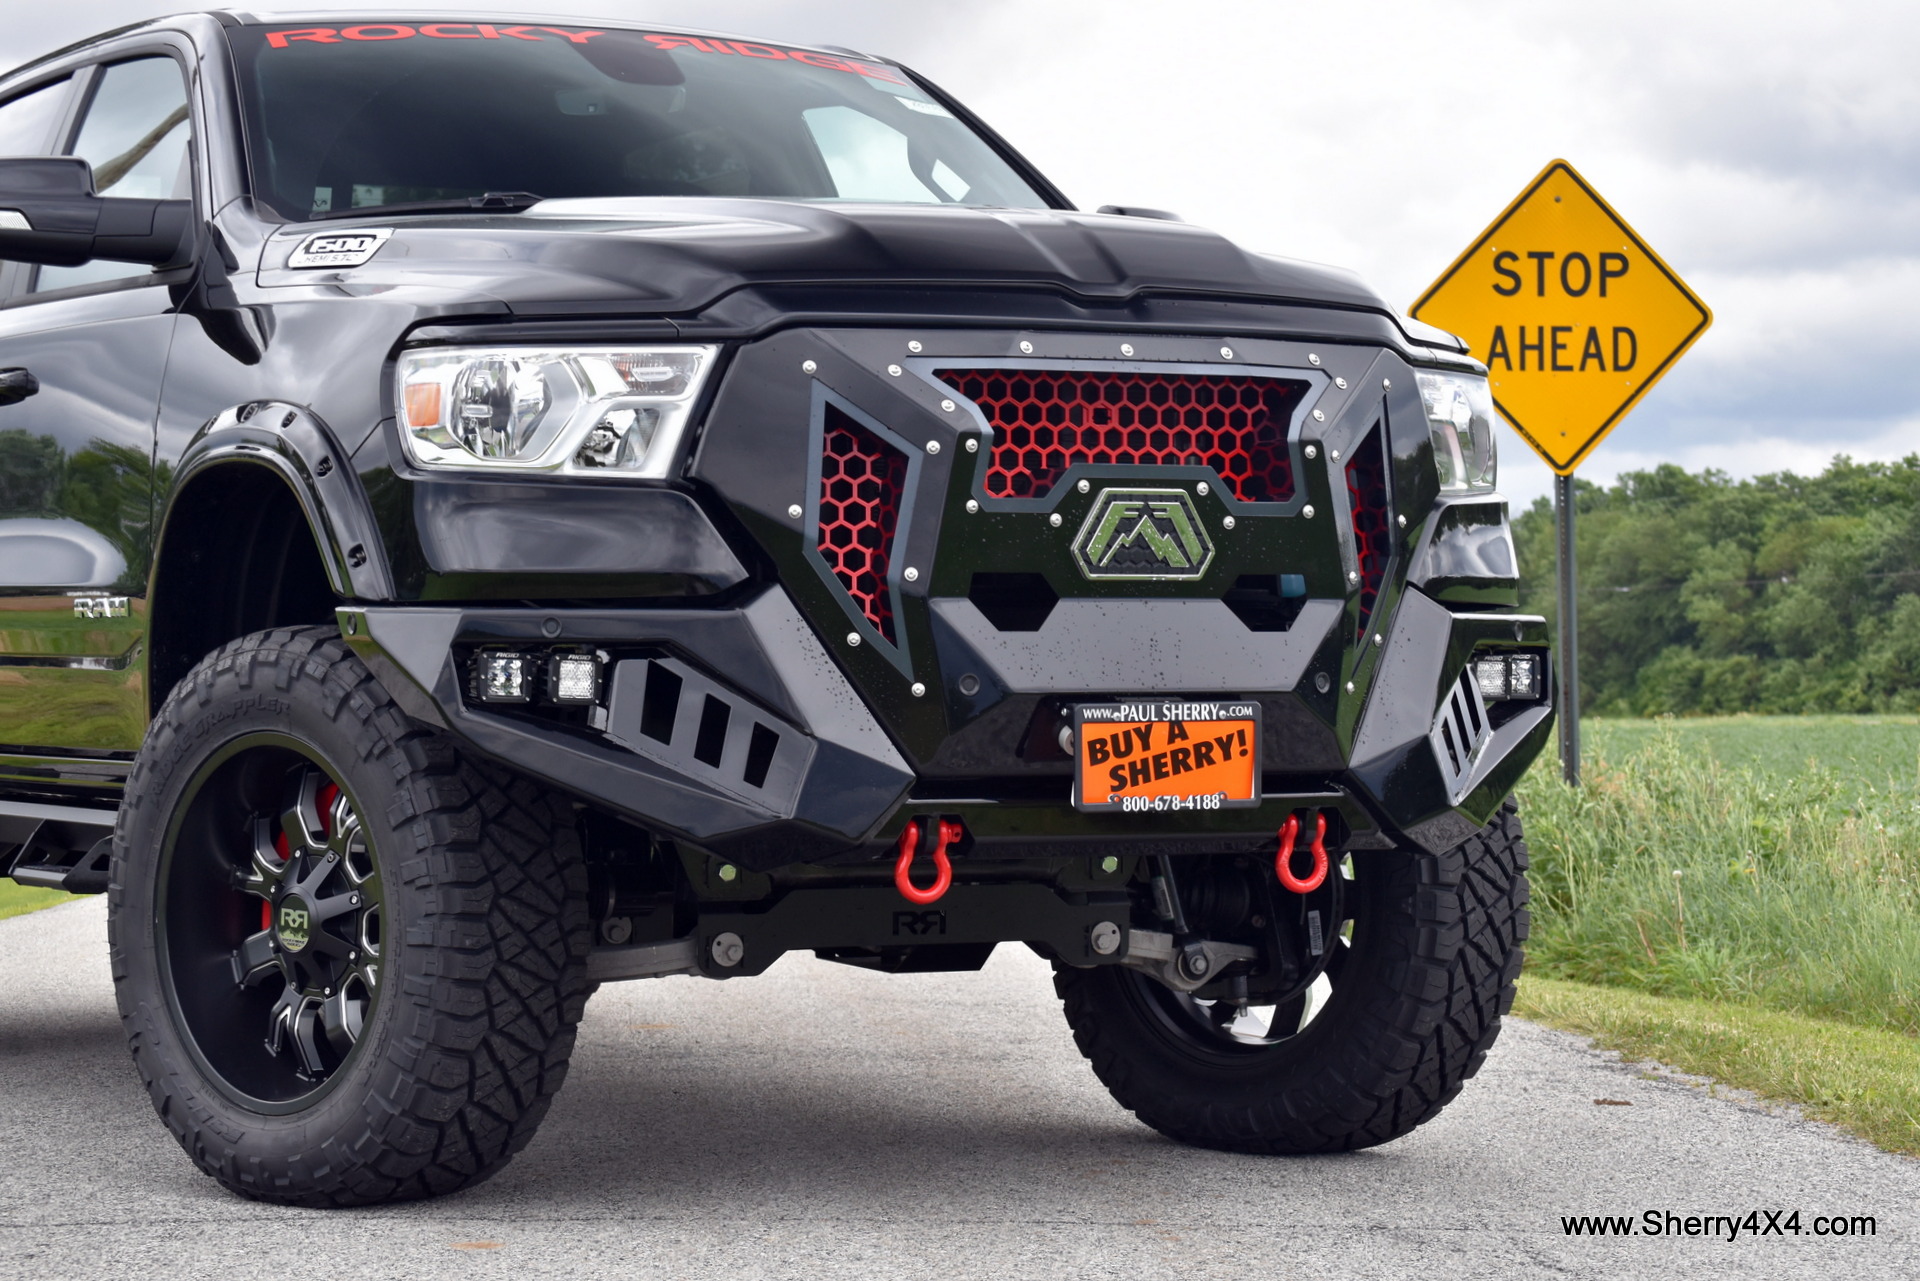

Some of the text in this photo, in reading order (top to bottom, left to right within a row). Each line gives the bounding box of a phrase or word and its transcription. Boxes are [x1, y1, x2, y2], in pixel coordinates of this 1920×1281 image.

[265, 24, 908, 86] ROCKY RIDGE
[308, 237, 375, 253] 1500
[1492, 251, 1630, 298] STOP
[1486, 325, 1637, 373] AHEAD
[74, 597, 130, 618] RAM
[1120, 704, 1158, 722] PAUL
[1162, 703, 1220, 722] SHERRY
[1087, 721, 1190, 767] BUY A
[1109, 729, 1249, 792] SHERRY!
[1122, 793, 1220, 812] 800-678-4188
